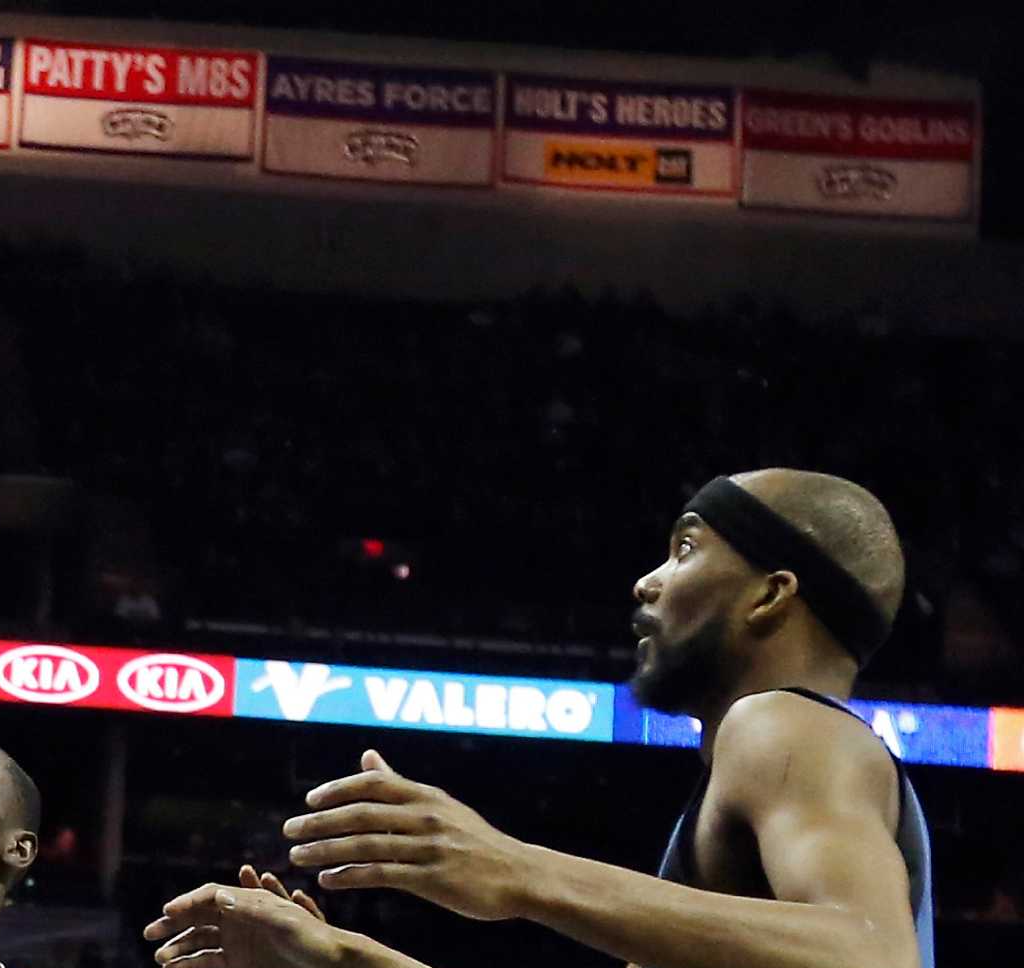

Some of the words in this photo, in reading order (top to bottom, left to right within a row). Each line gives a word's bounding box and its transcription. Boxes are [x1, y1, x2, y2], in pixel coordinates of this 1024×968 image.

[29, 46, 167, 96] PATTY'S
[178, 59, 252, 99] M8S
[271, 73, 376, 106] AYRES
[384, 81, 492, 113] FORCE
[513, 85, 609, 124] HOLT'S
[616, 92, 727, 131] HEROES
[551, 150, 647, 173] HOLT
[364, 676, 593, 734] VALERO
